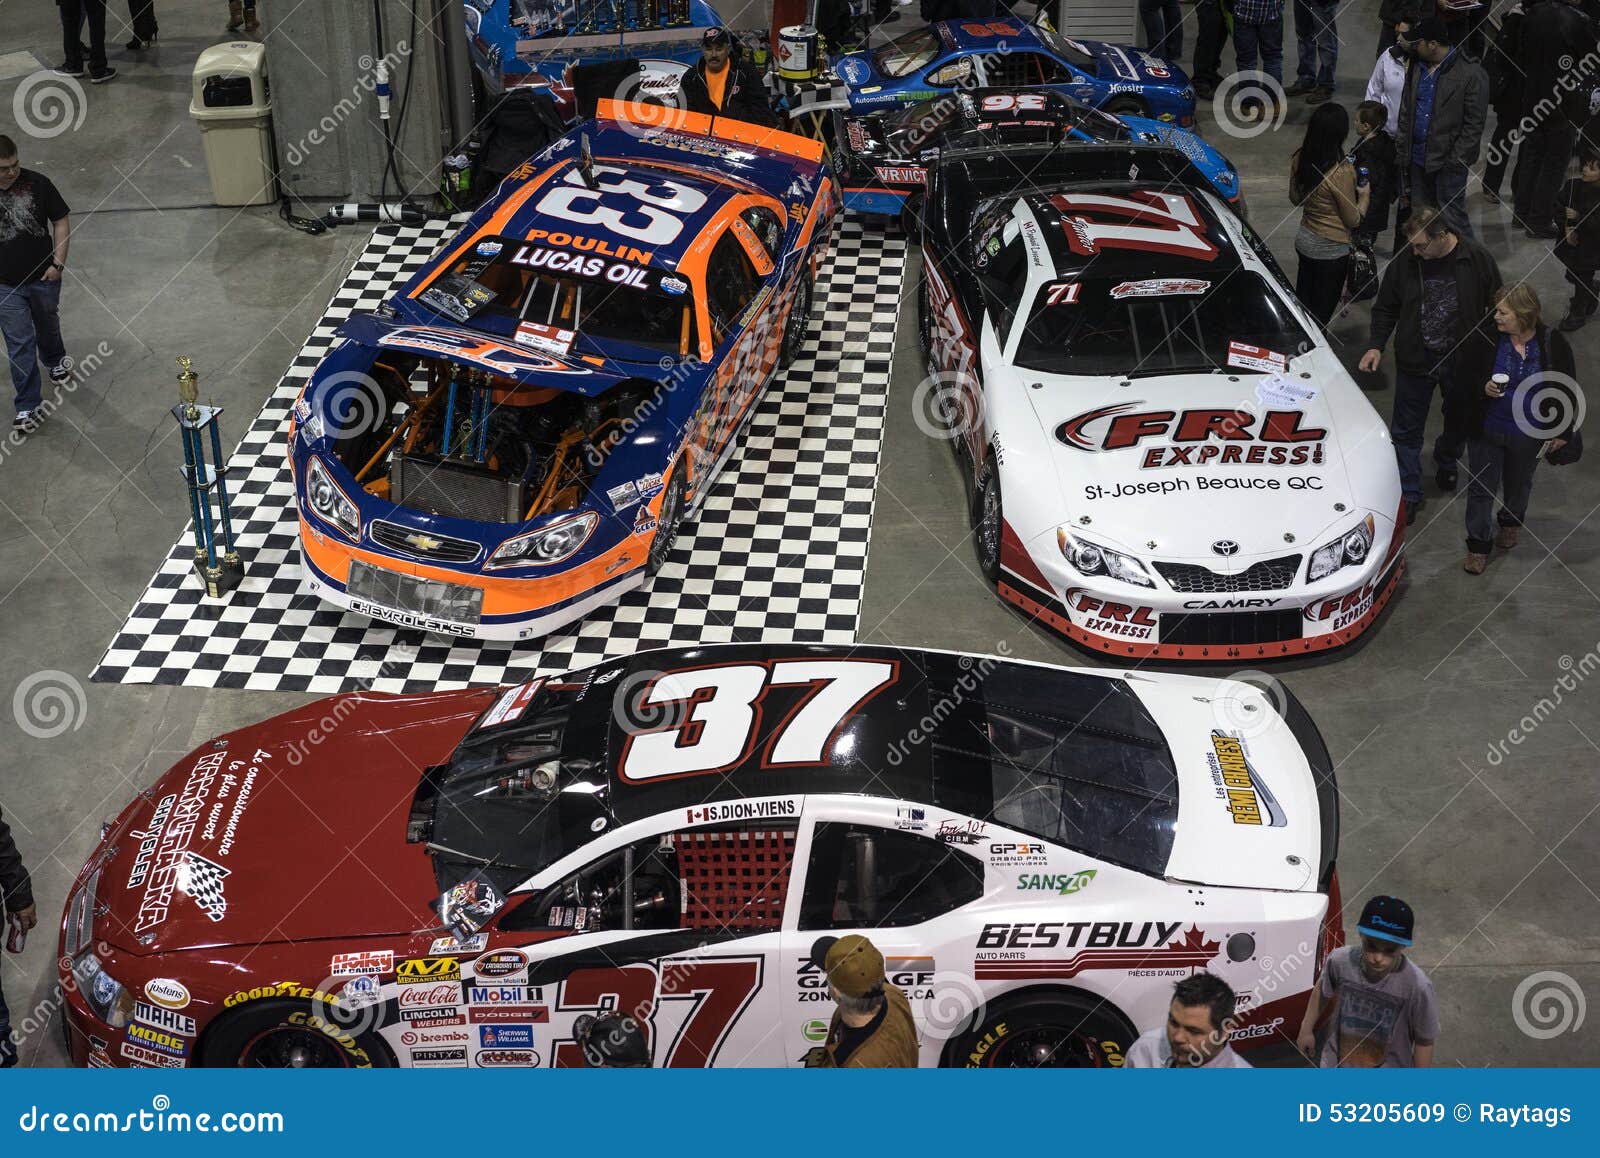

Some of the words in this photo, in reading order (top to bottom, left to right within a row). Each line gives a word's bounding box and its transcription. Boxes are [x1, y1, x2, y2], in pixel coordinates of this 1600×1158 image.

[1108, 83, 1144, 94] Hoosier
[878, 169, 900, 181] VR
[535, 164, 708, 245] 33
[525, 228, 654, 265] POULIN
[512, 246, 605, 276] LUCAS
[606, 265, 650, 289] OIL
[1047, 282, 1082, 305] 71
[1101, 409, 1327, 450] FRL
[1143, 446, 1309, 468] EXPRESS
[1085, 477, 1189, 500] St-Joseph
[1197, 476, 1280, 490] Beauce
[1287, 476, 1323, 490] QC
[350, 600, 448, 632] CHEVROLET
[1076, 596, 1157, 627] FRL
[1183, 599, 1281, 610] CAMRY
[618, 657, 899, 785] 37
[1211, 735, 1252, 788] CHAREST
[218, 773, 237, 799] plus
[710, 800, 794, 820] S.DION-VIENS
[127, 794, 177, 889] CHRYSLER
[333, 952, 392, 972] Holley
[975, 952, 997, 960] AUTO
[1000, 952, 1026, 960] PARTS
[438, 973, 460, 981] WEAR
[149, 980, 184, 1000] jostens
[223, 983, 341, 1008] GOODYEAR
[472, 988, 521, 1002] Mobil
[529, 988, 541, 1000] 1
[136, 1002, 195, 1033] MAHLE
[402, 1009, 454, 1019] LINCOLN
[550, 953, 765, 1068] 37
[416, 1019, 460, 1028] WELDERS
[128, 1024, 184, 1050] MOOG
[421, 1032, 469, 1042] brembo
[123, 1045, 169, 1066] COMP
[415, 1049, 463, 1059] PINTY'S
